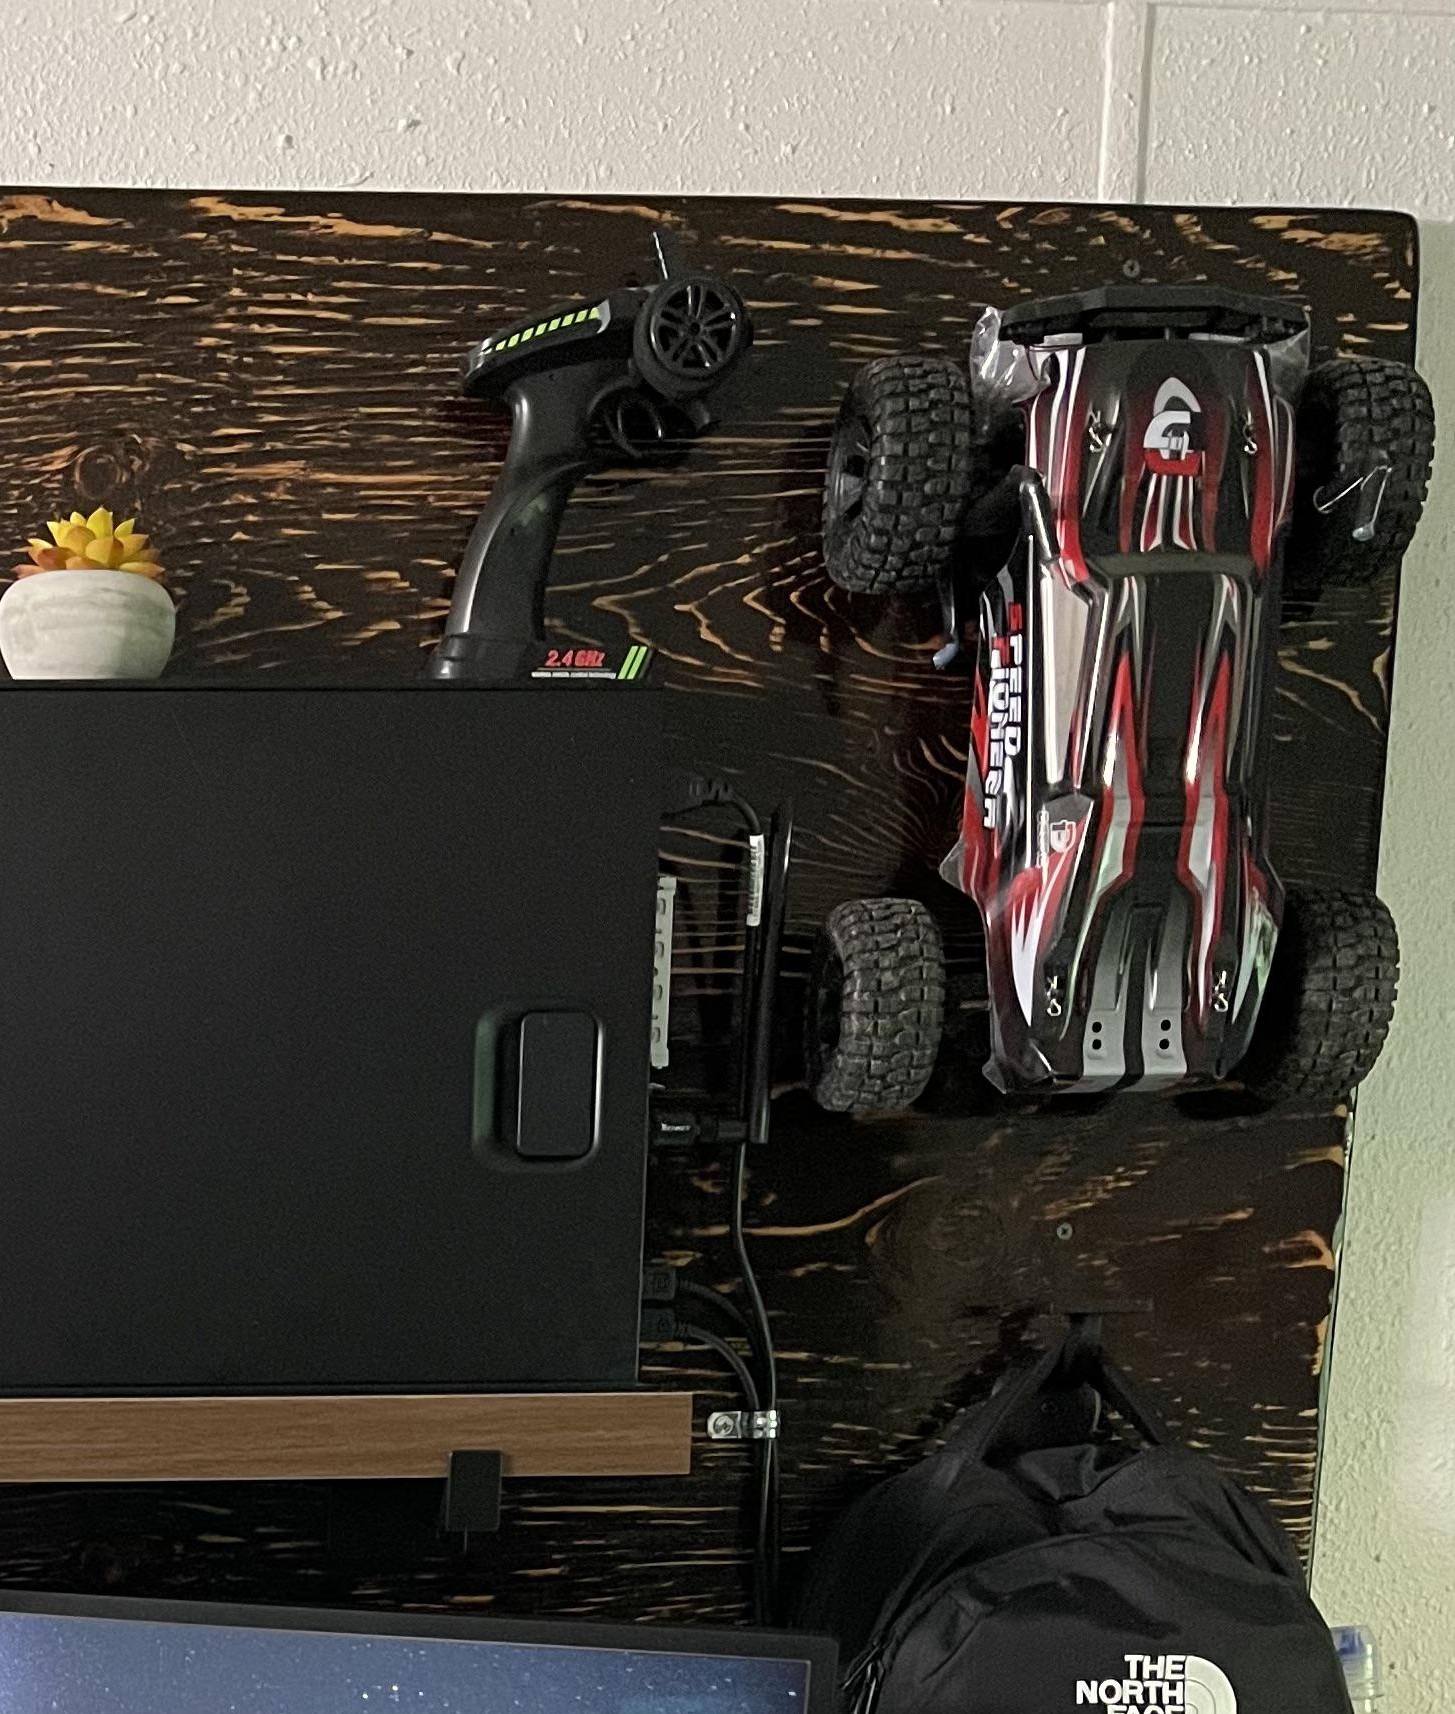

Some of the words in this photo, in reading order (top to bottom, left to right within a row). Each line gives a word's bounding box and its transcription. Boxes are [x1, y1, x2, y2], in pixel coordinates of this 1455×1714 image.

[1004, 602, 1023, 757] SPEED
[1124, 1654, 1187, 1680] THE
[1075, 1679, 1184, 1704] NORTH
